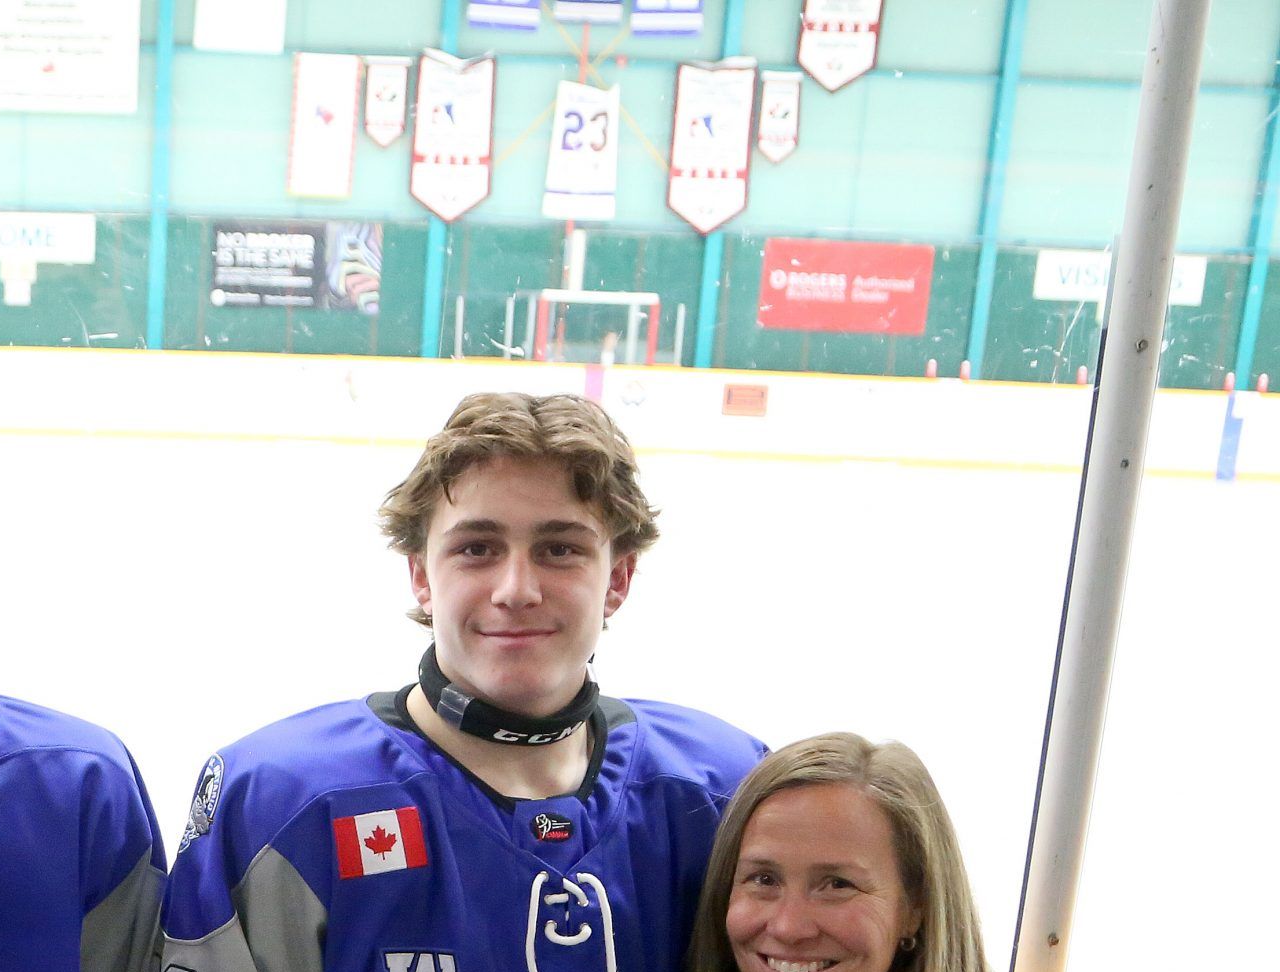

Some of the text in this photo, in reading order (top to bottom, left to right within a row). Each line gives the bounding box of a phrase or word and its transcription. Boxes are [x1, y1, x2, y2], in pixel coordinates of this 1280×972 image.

[562, 110, 609, 152] 23
[787, 271, 848, 289] ROGERS
[493, 720, 583, 743] CCM
